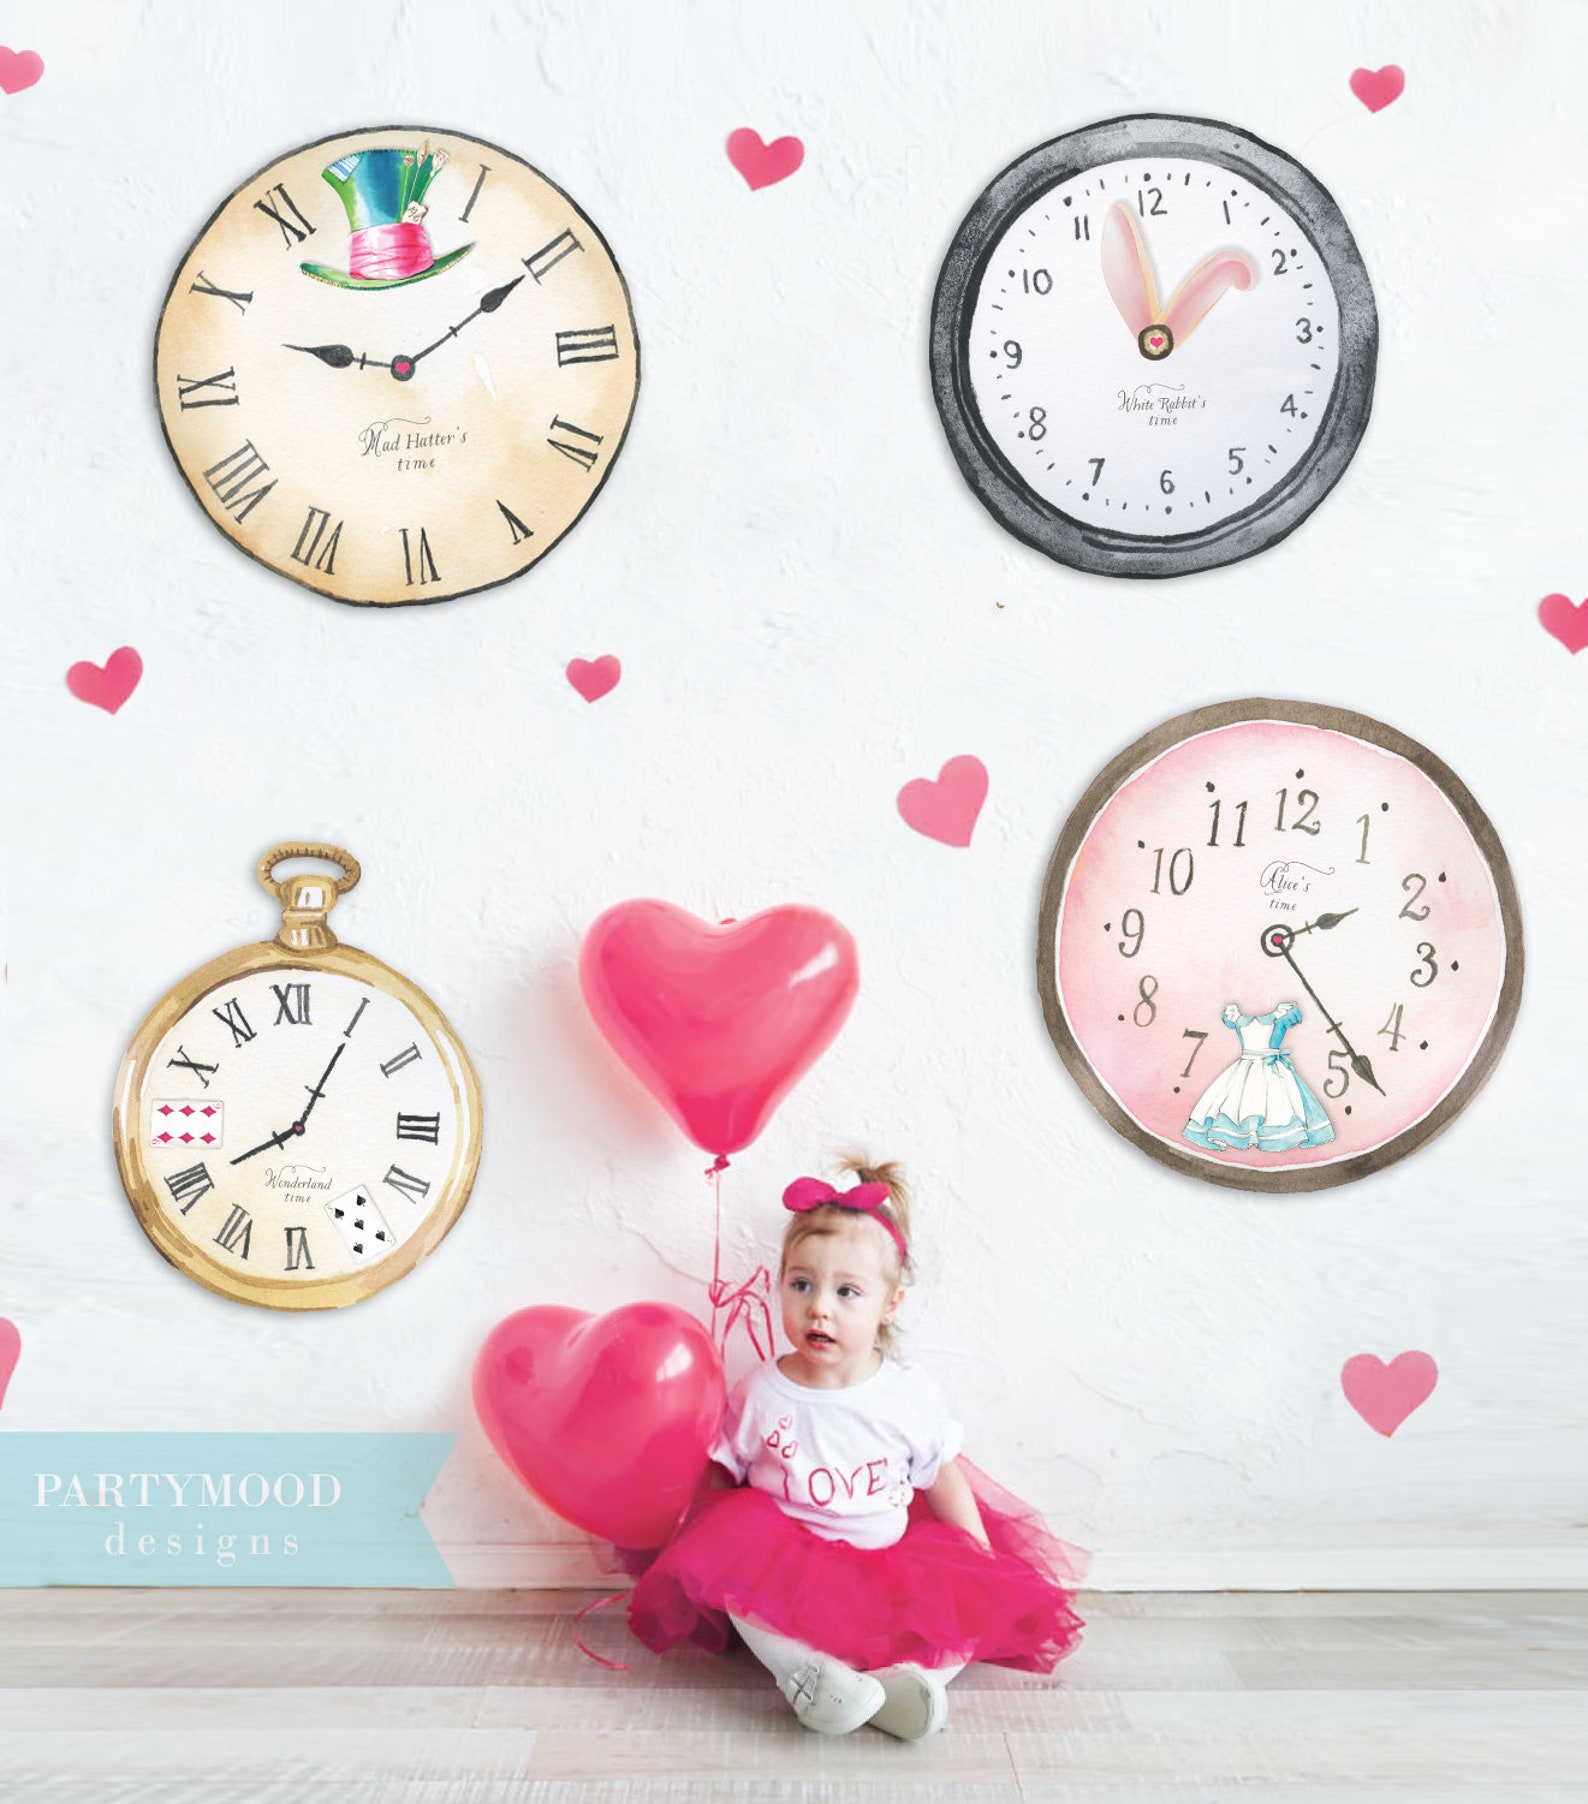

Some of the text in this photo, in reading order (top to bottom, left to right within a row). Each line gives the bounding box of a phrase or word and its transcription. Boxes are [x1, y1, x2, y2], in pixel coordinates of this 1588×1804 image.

[253, 183, 317, 250] XI
[1139, 188, 1167, 217] 12
[1075, 216, 1089, 240] 11
[521, 228, 586, 285] II
[1272, 249, 1287, 275] 2
[189, 271, 254, 315] X
[1023, 269, 1052, 295] 10
[556, 324, 619, 367] III
[1296, 318, 1312, 343] 3
[1004, 340, 1022, 369] 9
[177, 366, 240, 413] IX
[1118, 386, 1207, 414] White Rabbit's
[1280, 394, 1298, 417] 4
[358, 418, 468, 458] Mad Hatter's
[1029, 407, 1046, 441] 8
[1149, 415, 1178, 426] time
[397, 458, 437, 471] time
[547, 415, 604, 472] IV
[1229, 448, 1245, 475] 5
[204, 439, 279, 525] VIII
[1089, 458, 1105, 486] 7
[1160, 470, 1174, 494] 6
[290, 505, 344, 575] VII
[496, 499, 535, 545] V
[400, 527, 442, 586] VI
[1207, 800, 1247, 847] 11
[1275, 788, 1320, 835] 12
[1152, 848, 1193, 895] 10
[1260, 861, 1319, 895] Alice's
[1269, 899, 1297, 911] time
[1399, 874, 1431, 921] 2
[1119, 909, 1144, 958] 9
[1410, 942, 1438, 987] 3
[213, 998, 258, 1048] XI
[270, 984, 311, 1025] XII
[1134, 976, 1158, 1027] 8
[1378, 1004, 1405, 1051] 4
[167, 1046, 219, 1088] X
[380, 1042, 422, 1078] II
[1182, 1028, 1209, 1079] 7
[1323, 1048, 1350, 1099] 5
[397, 1112, 440, 1145] III
[164, 1162, 215, 1216] VIII
[264, 1166, 333, 1190] Wonderland
[284, 1193, 311, 1203] time
[383, 1164, 430, 1201] IV
[213, 1203, 253, 1260] VII
[284, 1227, 315, 1270] VI
[780, 1458, 888, 1507] LOVE
